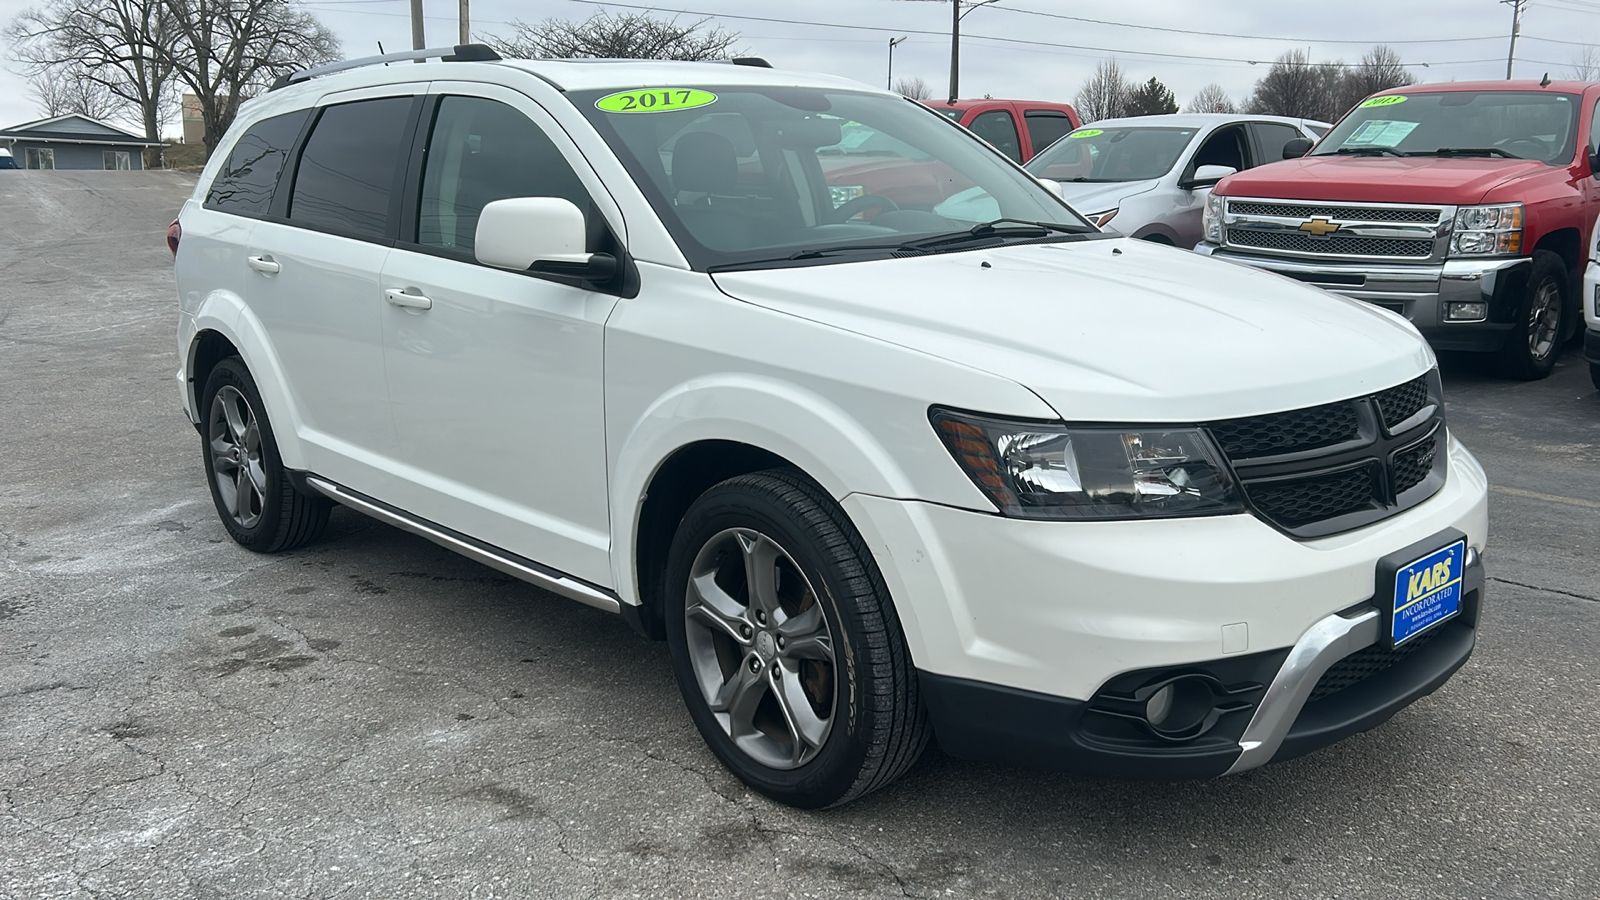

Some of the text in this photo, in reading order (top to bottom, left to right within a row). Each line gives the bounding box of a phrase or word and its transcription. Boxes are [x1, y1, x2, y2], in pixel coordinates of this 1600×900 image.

[619, 90, 692, 111] 2017
[1365, 96, 1401, 106] 2013
[1406, 557, 1452, 602] KARS
[1402, 586, 1453, 620] INCORPORATED
